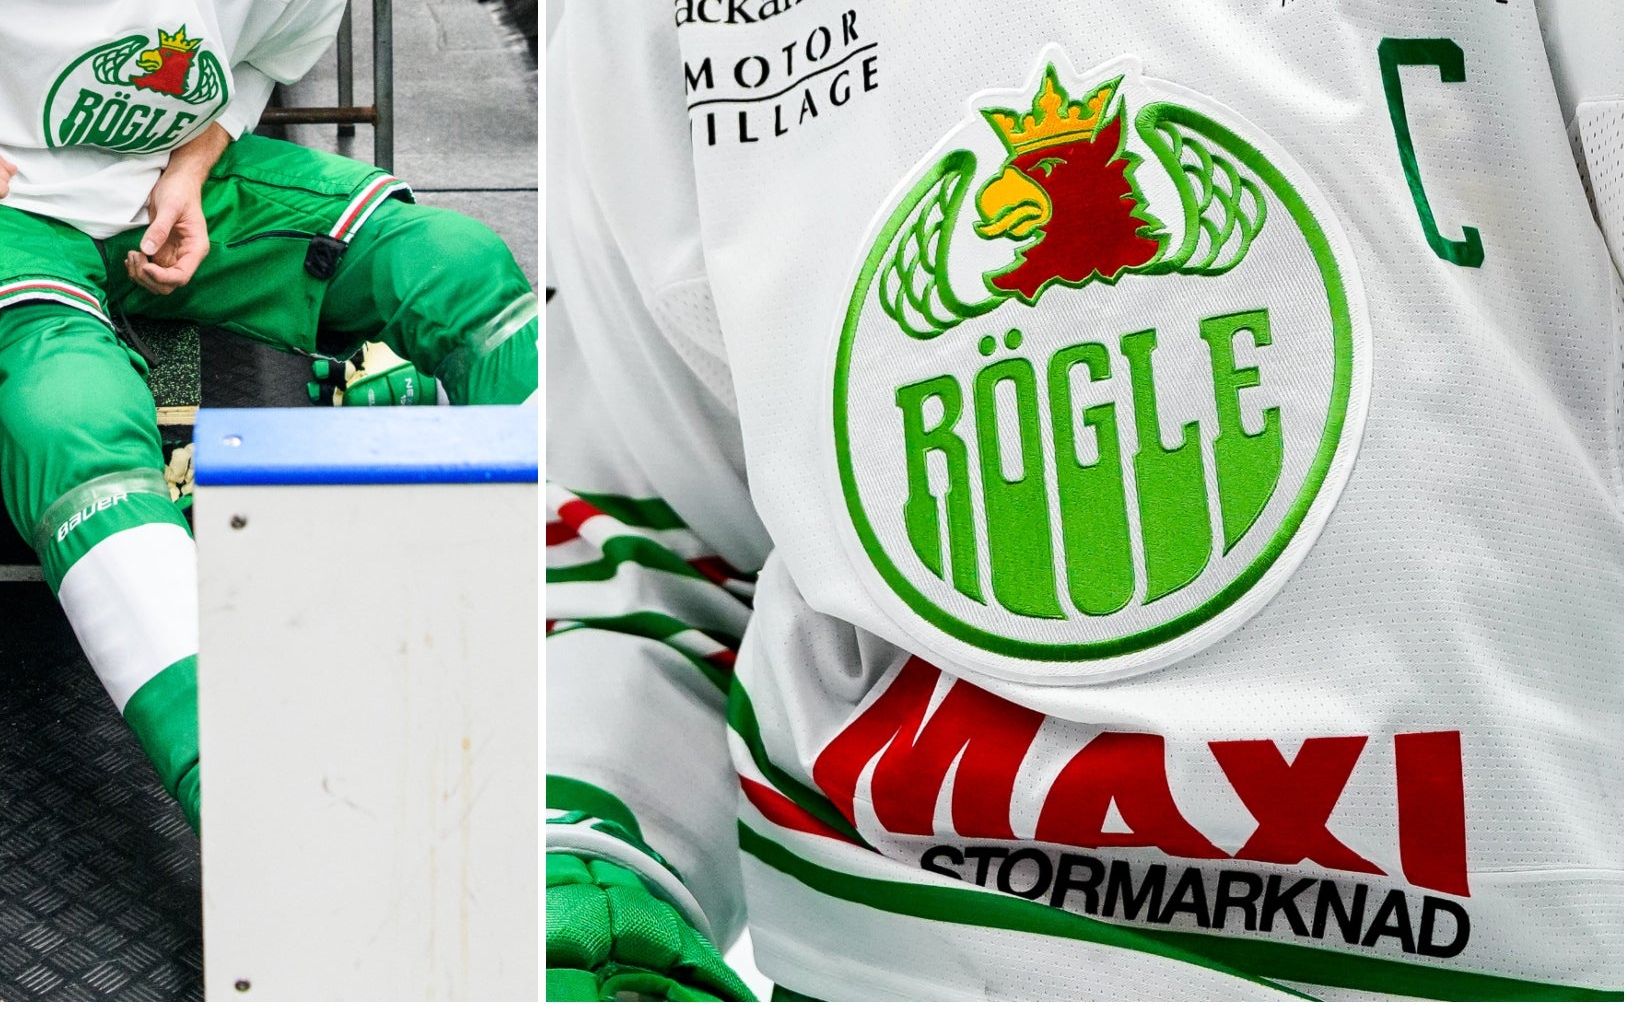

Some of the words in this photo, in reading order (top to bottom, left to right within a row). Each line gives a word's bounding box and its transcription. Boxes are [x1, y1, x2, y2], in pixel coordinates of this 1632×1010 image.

[684, 9, 859, 96] MOTOR
[689, 55, 879, 147] ILLAGE
[58, 87, 199, 151] RÖGLE
[1377, 37, 1486, 269] C
[895, 307, 1284, 621] RÖGLE
[812, 655, 1471, 898] MAXI
[919, 844, 1472, 960] STORMARKNAD
